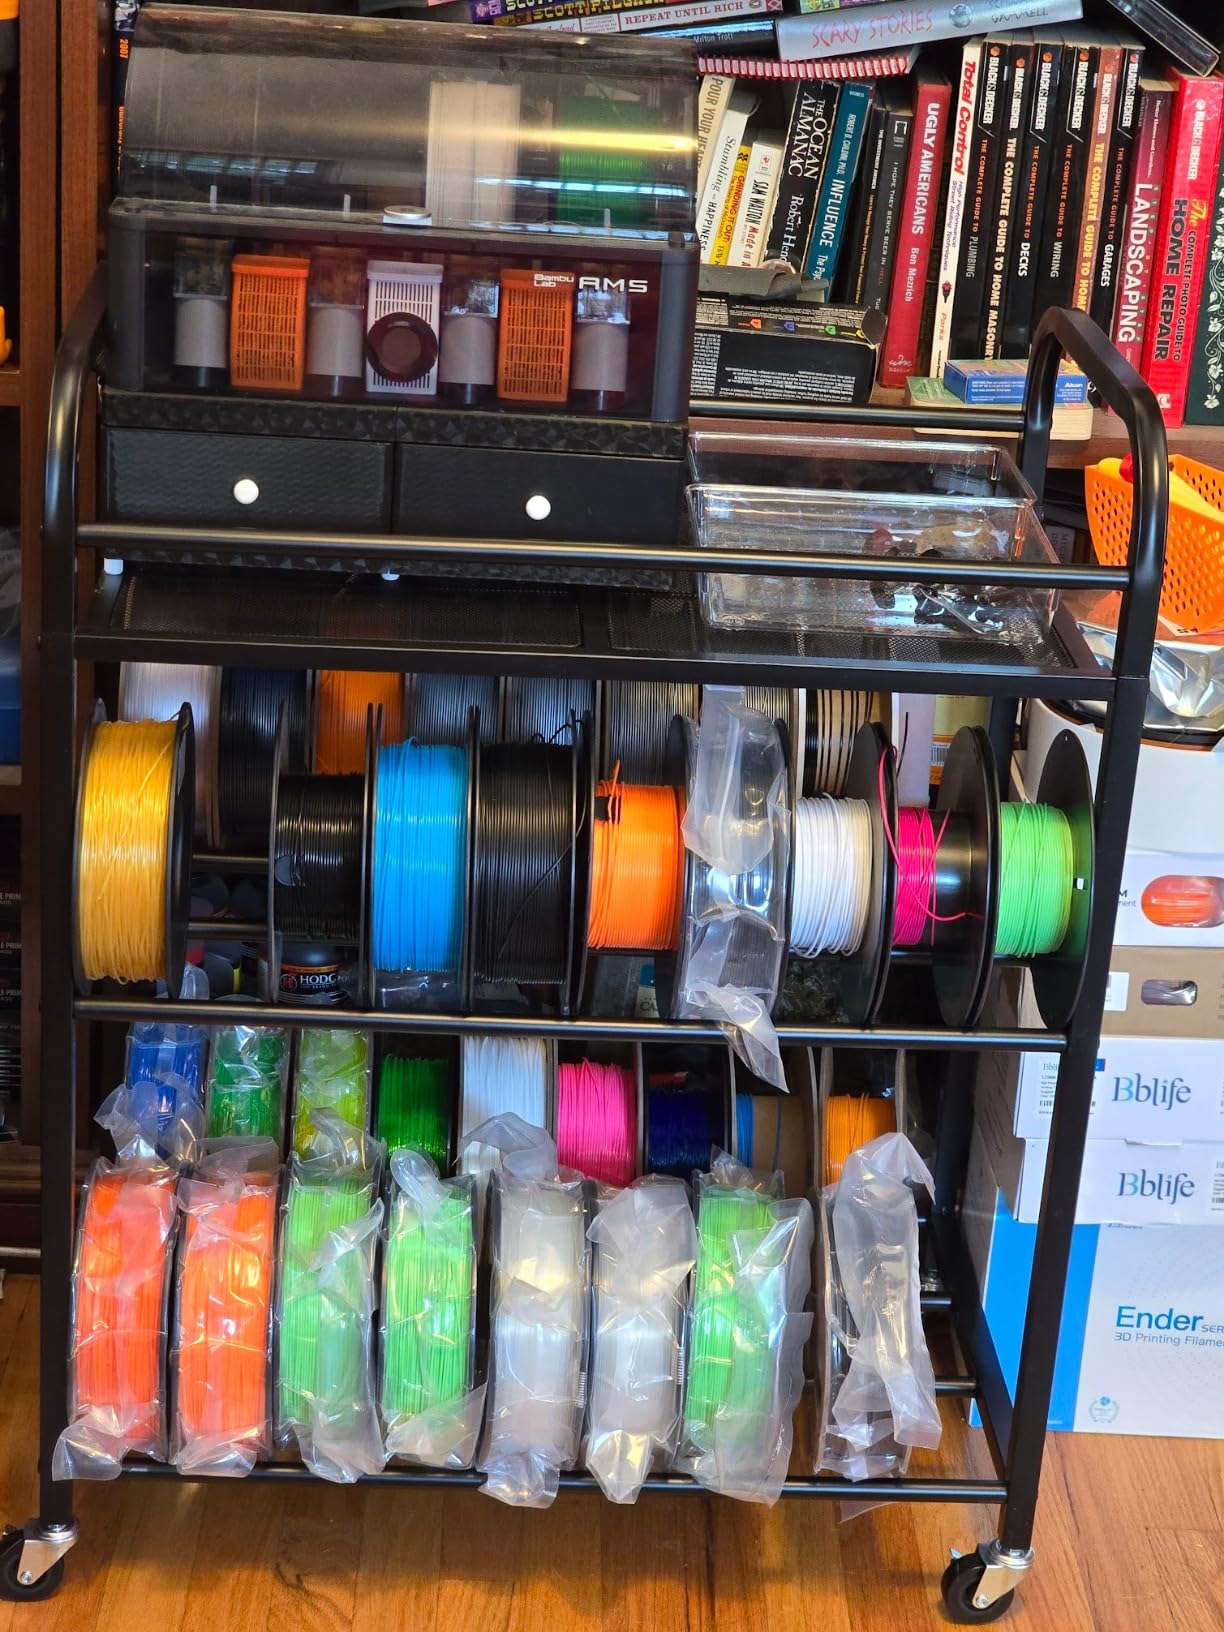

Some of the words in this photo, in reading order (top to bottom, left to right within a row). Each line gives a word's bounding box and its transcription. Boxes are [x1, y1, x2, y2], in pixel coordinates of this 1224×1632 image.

[533, 1, 585, 20] SCOTT
[592, 0, 664, 12] PILG
[625, 12, 672, 25] REPEAT
[675, 6, 711, 18] UNTIL
[714, 1, 744, 13] RICH
[812, 19, 861, 48] SCARY
[870, 8, 933, 40] STORIES
[119, 38, 129, 59] 2007
[705, 77, 723, 106] POUR
[962, 61, 976, 105] Total
[698, 107, 716, 134] YOUR
[814, 99, 826, 117] THE
[788, 91, 816, 177] ALMANAC
[845, 113, 857, 134] ROBERT
[924, 103, 941, 148] UGLY
[803, 117, 828, 180] OCEAN
[953, 106, 971, 176] Control
[1006, 138, 1017, 158] THE
[1093, 143, 1105, 163] THE
[711, 135, 737, 192] Stumbling
[890, 167, 900, 187] HOPE
[976, 155, 986, 194] COMPLETE
[730, 175, 745, 215] GRINDING
[751, 180, 769, 196] SAM
[911, 149, 934, 235] AMERICANS
[1000, 161, 1014, 216] COMPLETE
[1028, 161, 1038, 200] COMPLETE
[1060, 160, 1070, 200] COMPLETE
[1087, 166, 1102, 222] COMPLETE
[1112, 163, 1122, 202] COMPLETE
[745, 197, 766, 226] WALTON
[785, 194, 804, 232] Robert
[819, 178, 846, 248] INFLUENCE
[888, 189, 896, 208] THEY
[973, 197, 981, 220] GUIDE
[1057, 202, 1065, 225] GUIDE
[1189, 198, 1208, 227] The
[700, 201, 718, 251] HAPPINESS
[884, 210, 892, 234] SERVE
[972, 222, 979, 233] TO
[1024, 203, 1033, 226] GUIDE
[1109, 205, 1117, 228] GUIDE
[745, 225, 759, 249] Made
[995, 219, 1008, 253] GUIDE
[1023, 229, 1030, 239] TO
[1056, 228, 1063, 238] TO
[1083, 224, 1095, 258] GUIDE
[1107, 230, 1115, 240] TO
[1165, 198, 1188, 276] HOME
[743, 250, 753, 259] in
[816, 254, 828, 266] The
[880, 257, 886, 265] IN
[909, 247, 919, 265] Ben
[966, 236, 979, 278] PLUMBING
[993, 256, 1004, 271] TO
[1017, 242, 1030, 277] DECKS
[1050, 241, 1063, 278] WIRING
[1080, 261, 1091, 276] TO
[1100, 243, 1114, 287] GARAGES
[1118, 183, 1153, 343] LANDSCAPING
[1183, 230, 1196, 280] COMPLETE
[534, 273, 574, 283] Bambu
[578, 276, 648, 293] AMS
[534, 280, 556, 288] Lab
[905, 268, 917, 302] Mezrich
[990, 274, 1002, 307] HOME
[1179, 282, 1190, 316] PHOTO
[984, 309, 998, 360] MASONRY
[1154, 283, 1177, 361] REPAIR
[1174, 317, 1185, 349] GUIDE
[1173, 349, 1182, 361] TO
[1112, 1072, 1192, 1111] Bblife
[1117, 1168, 1195, 1205] Bblife
[1116, 1305, 1204, 1332] Ender
[1114, 1332, 1132, 1342] 3D
[1135, 1333, 1181, 1347] Printing
